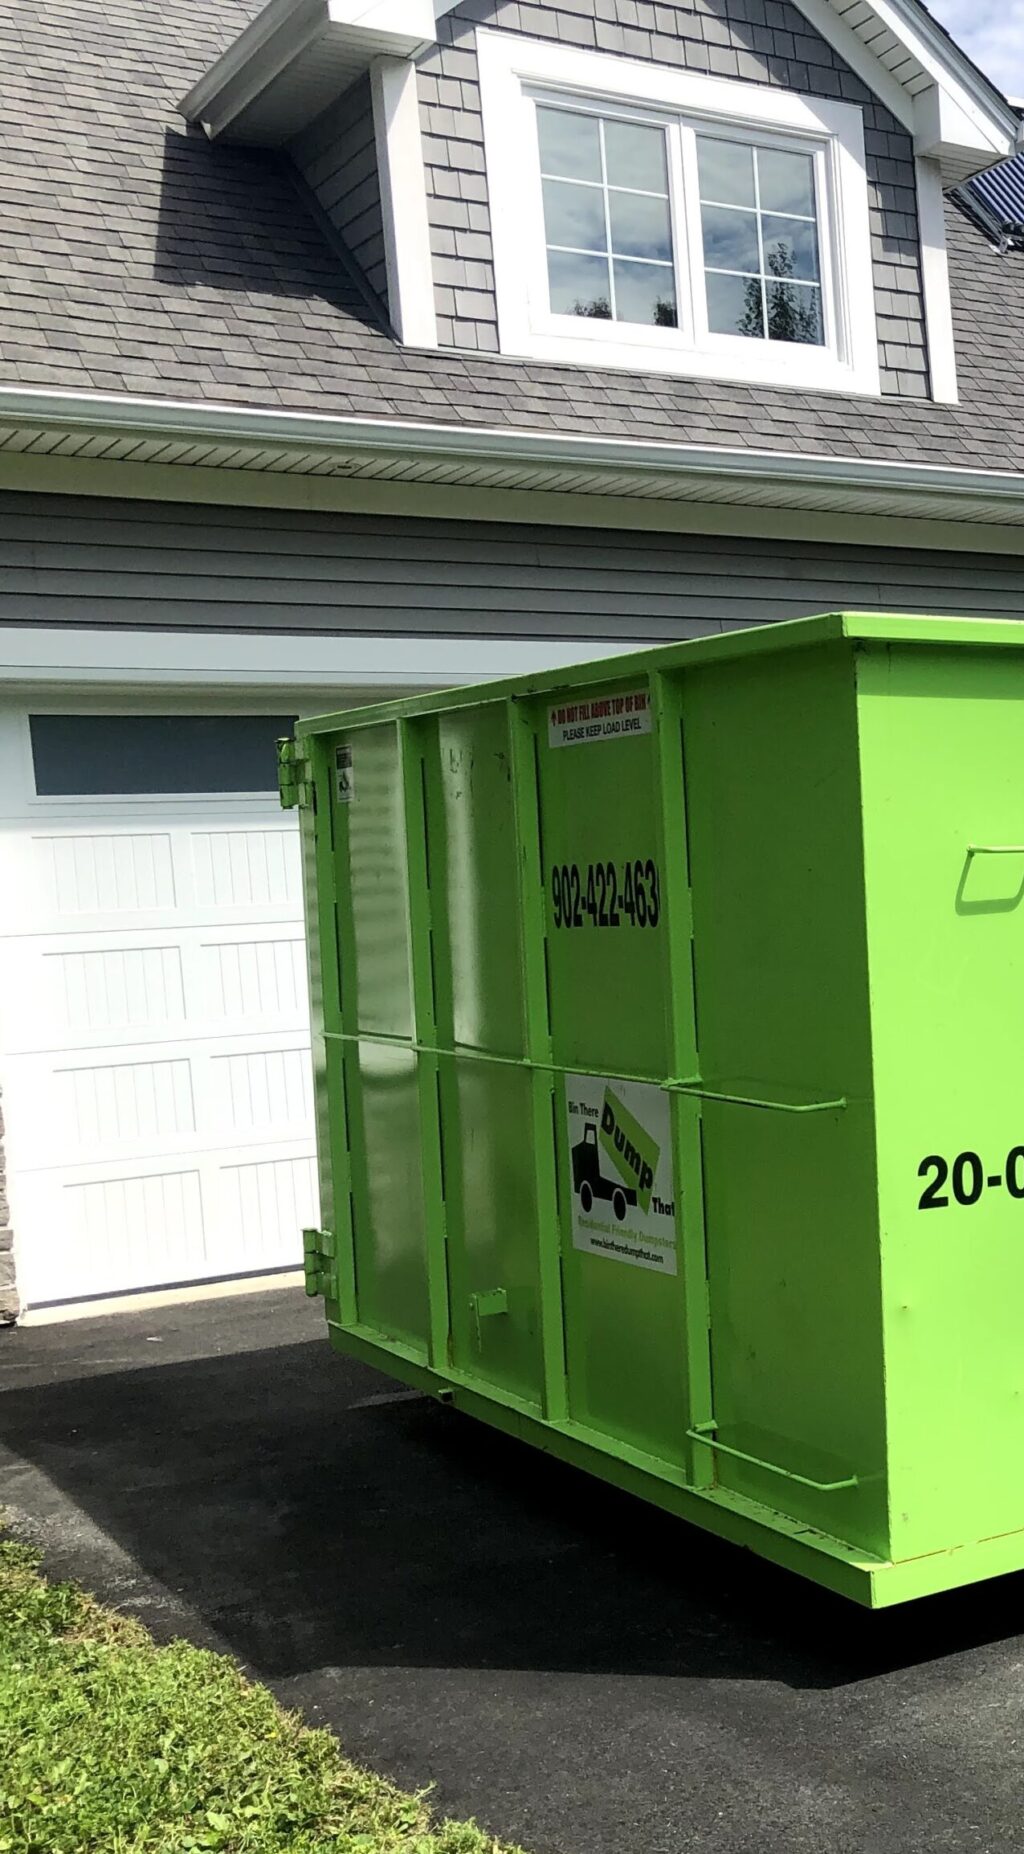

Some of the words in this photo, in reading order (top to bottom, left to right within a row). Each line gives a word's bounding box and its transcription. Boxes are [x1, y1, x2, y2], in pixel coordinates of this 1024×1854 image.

[579, 703, 590, 720] FILL
[611, 697, 624, 716] TOP
[562, 726, 585, 741] PLEASE
[586, 724, 601, 737] KEEP
[602, 721, 620, 735] LOAD
[621, 717, 642, 730] LEVEL
[552, 859, 660, 929] 902-422-463
[568, 1101, 579, 1115] Bin
[579, 1102, 599, 1118] There
[601, 1101, 653, 1191] Dump
